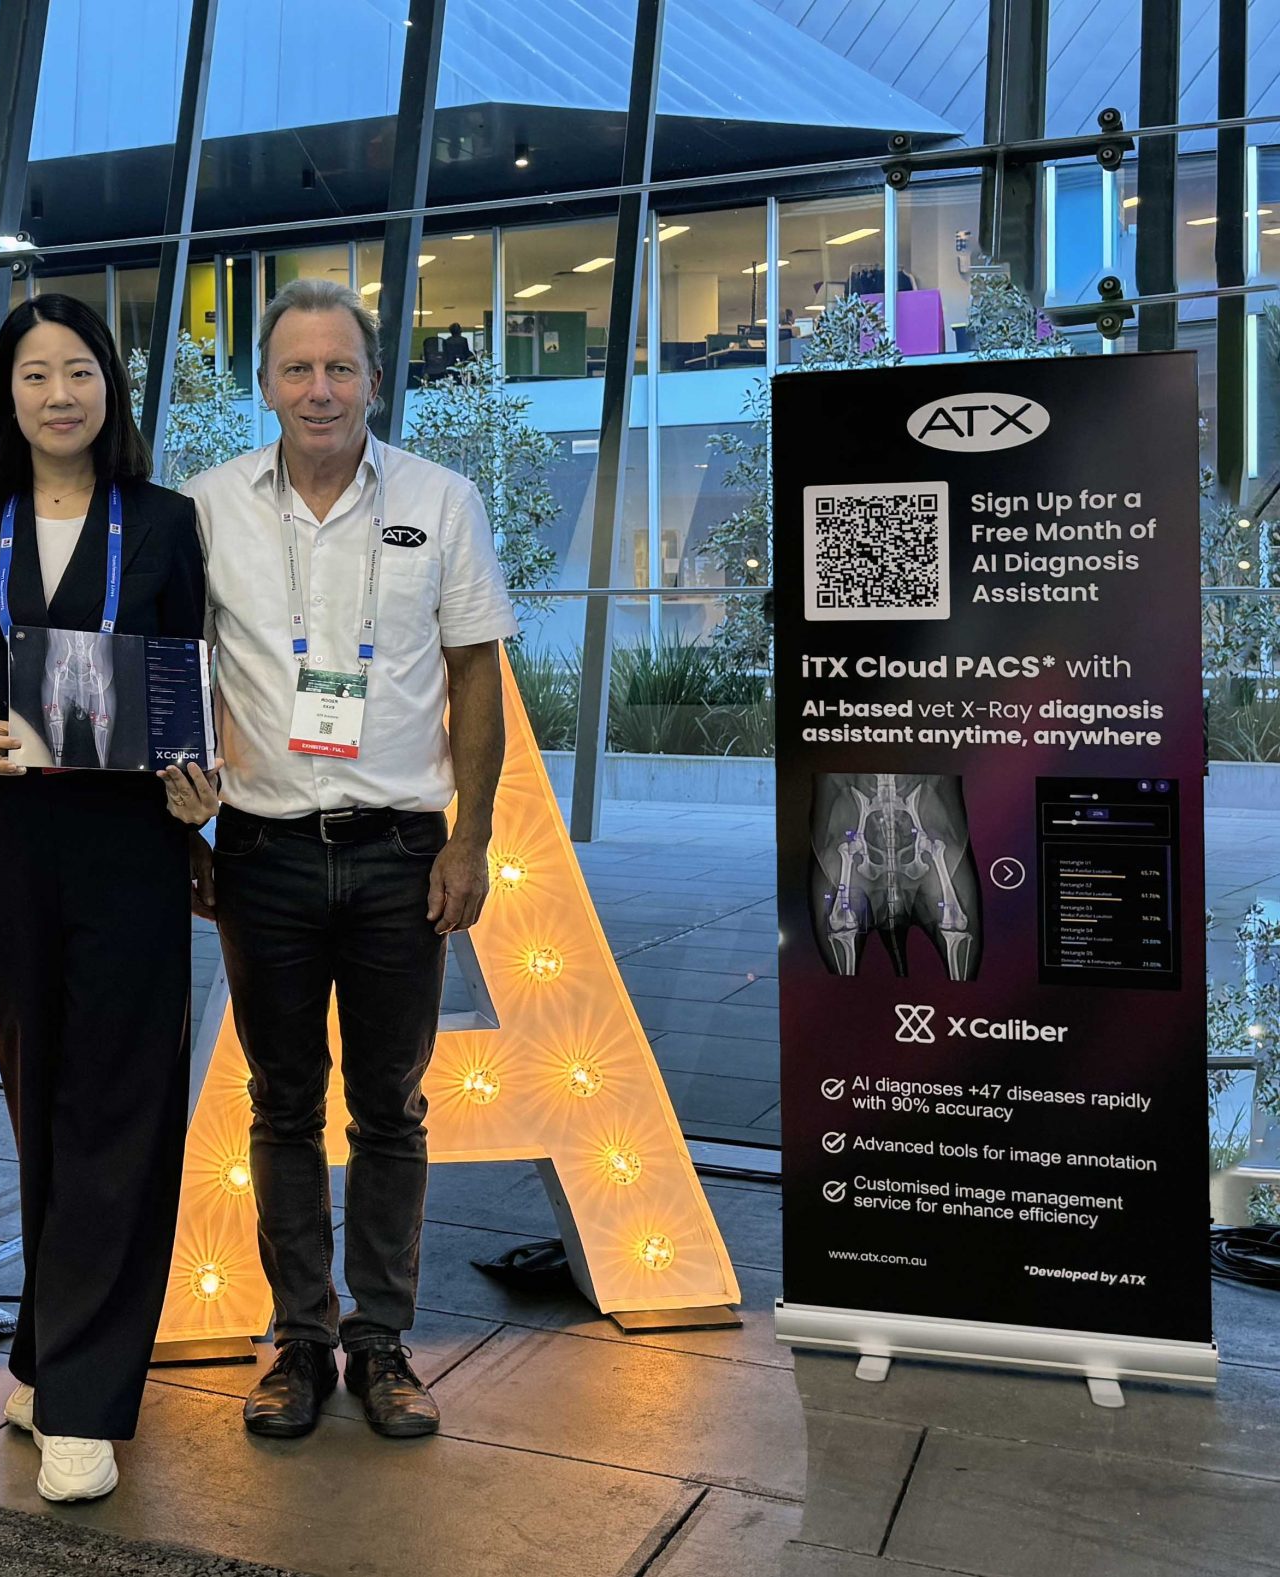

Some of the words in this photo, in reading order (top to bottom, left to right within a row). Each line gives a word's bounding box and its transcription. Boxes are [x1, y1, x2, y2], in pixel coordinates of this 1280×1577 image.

[917, 402, 1033, 438] ATX
[971, 492, 1029, 518] Sign
[1036, 492, 1073, 516] Up
[1078, 490, 1117, 509] for
[1123, 493, 1142, 508] a
[382, 529, 422, 544] ATX
[971, 525, 1029, 542] Free
[1035, 520, 1122, 541] Month
[1129, 518, 1157, 538] of
[971, 554, 997, 572] AI
[1004, 550, 1140, 577] Diagnosis
[971, 582, 1099, 602] Assistant
[801, 655, 849, 677] iTX
[855, 656, 948, 678] Cloud
[1065, 655, 1131, 677] with
[801, 700, 913, 717] AI-based
[917, 702, 955, 717] vet
[961, 701, 1033, 724] X-Ray
[1038, 699, 1164, 723] diagnosis
[801, 724, 914, 742] assistant
[917, 725, 1028, 749] anytime,
[1033, 727, 1162, 750] anywhere
[851, 1076, 870, 1090] AI
[875, 1078, 963, 1096] diagnoses
[968, 1084, 1002, 1098] +47
[1006, 1086, 1086, 1104] diseases
[1091, 1092, 1152, 1112] rapidly
[851, 1095, 887, 1110] with
[891, 1097, 930, 1113] 90%
[935, 1103, 1014, 1122] accuracy
[852, 1136, 934, 1154] Advanced
[939, 1143, 979, 1158] tools
[982, 1145, 1006, 1160] for
[1009, 1147, 1062, 1166] image
[1066, 1154, 1157, 1171] annotation
[853, 1176, 950, 1196] Customised
[955, 1183, 1006, 1203] image
[1011, 1191, 1124, 1210] management
[853, 1196, 911, 1210] service
[915, 1198, 939, 1212] for
[942, 1201, 1014, 1219] enhance
[1018, 1207, 1099, 1229] efficiency
[827, 1251, 927, 1266] www.atx.com.au
[1099, 1272, 1118, 1285] by
[1119, 1274, 1147, 1285] ATX
